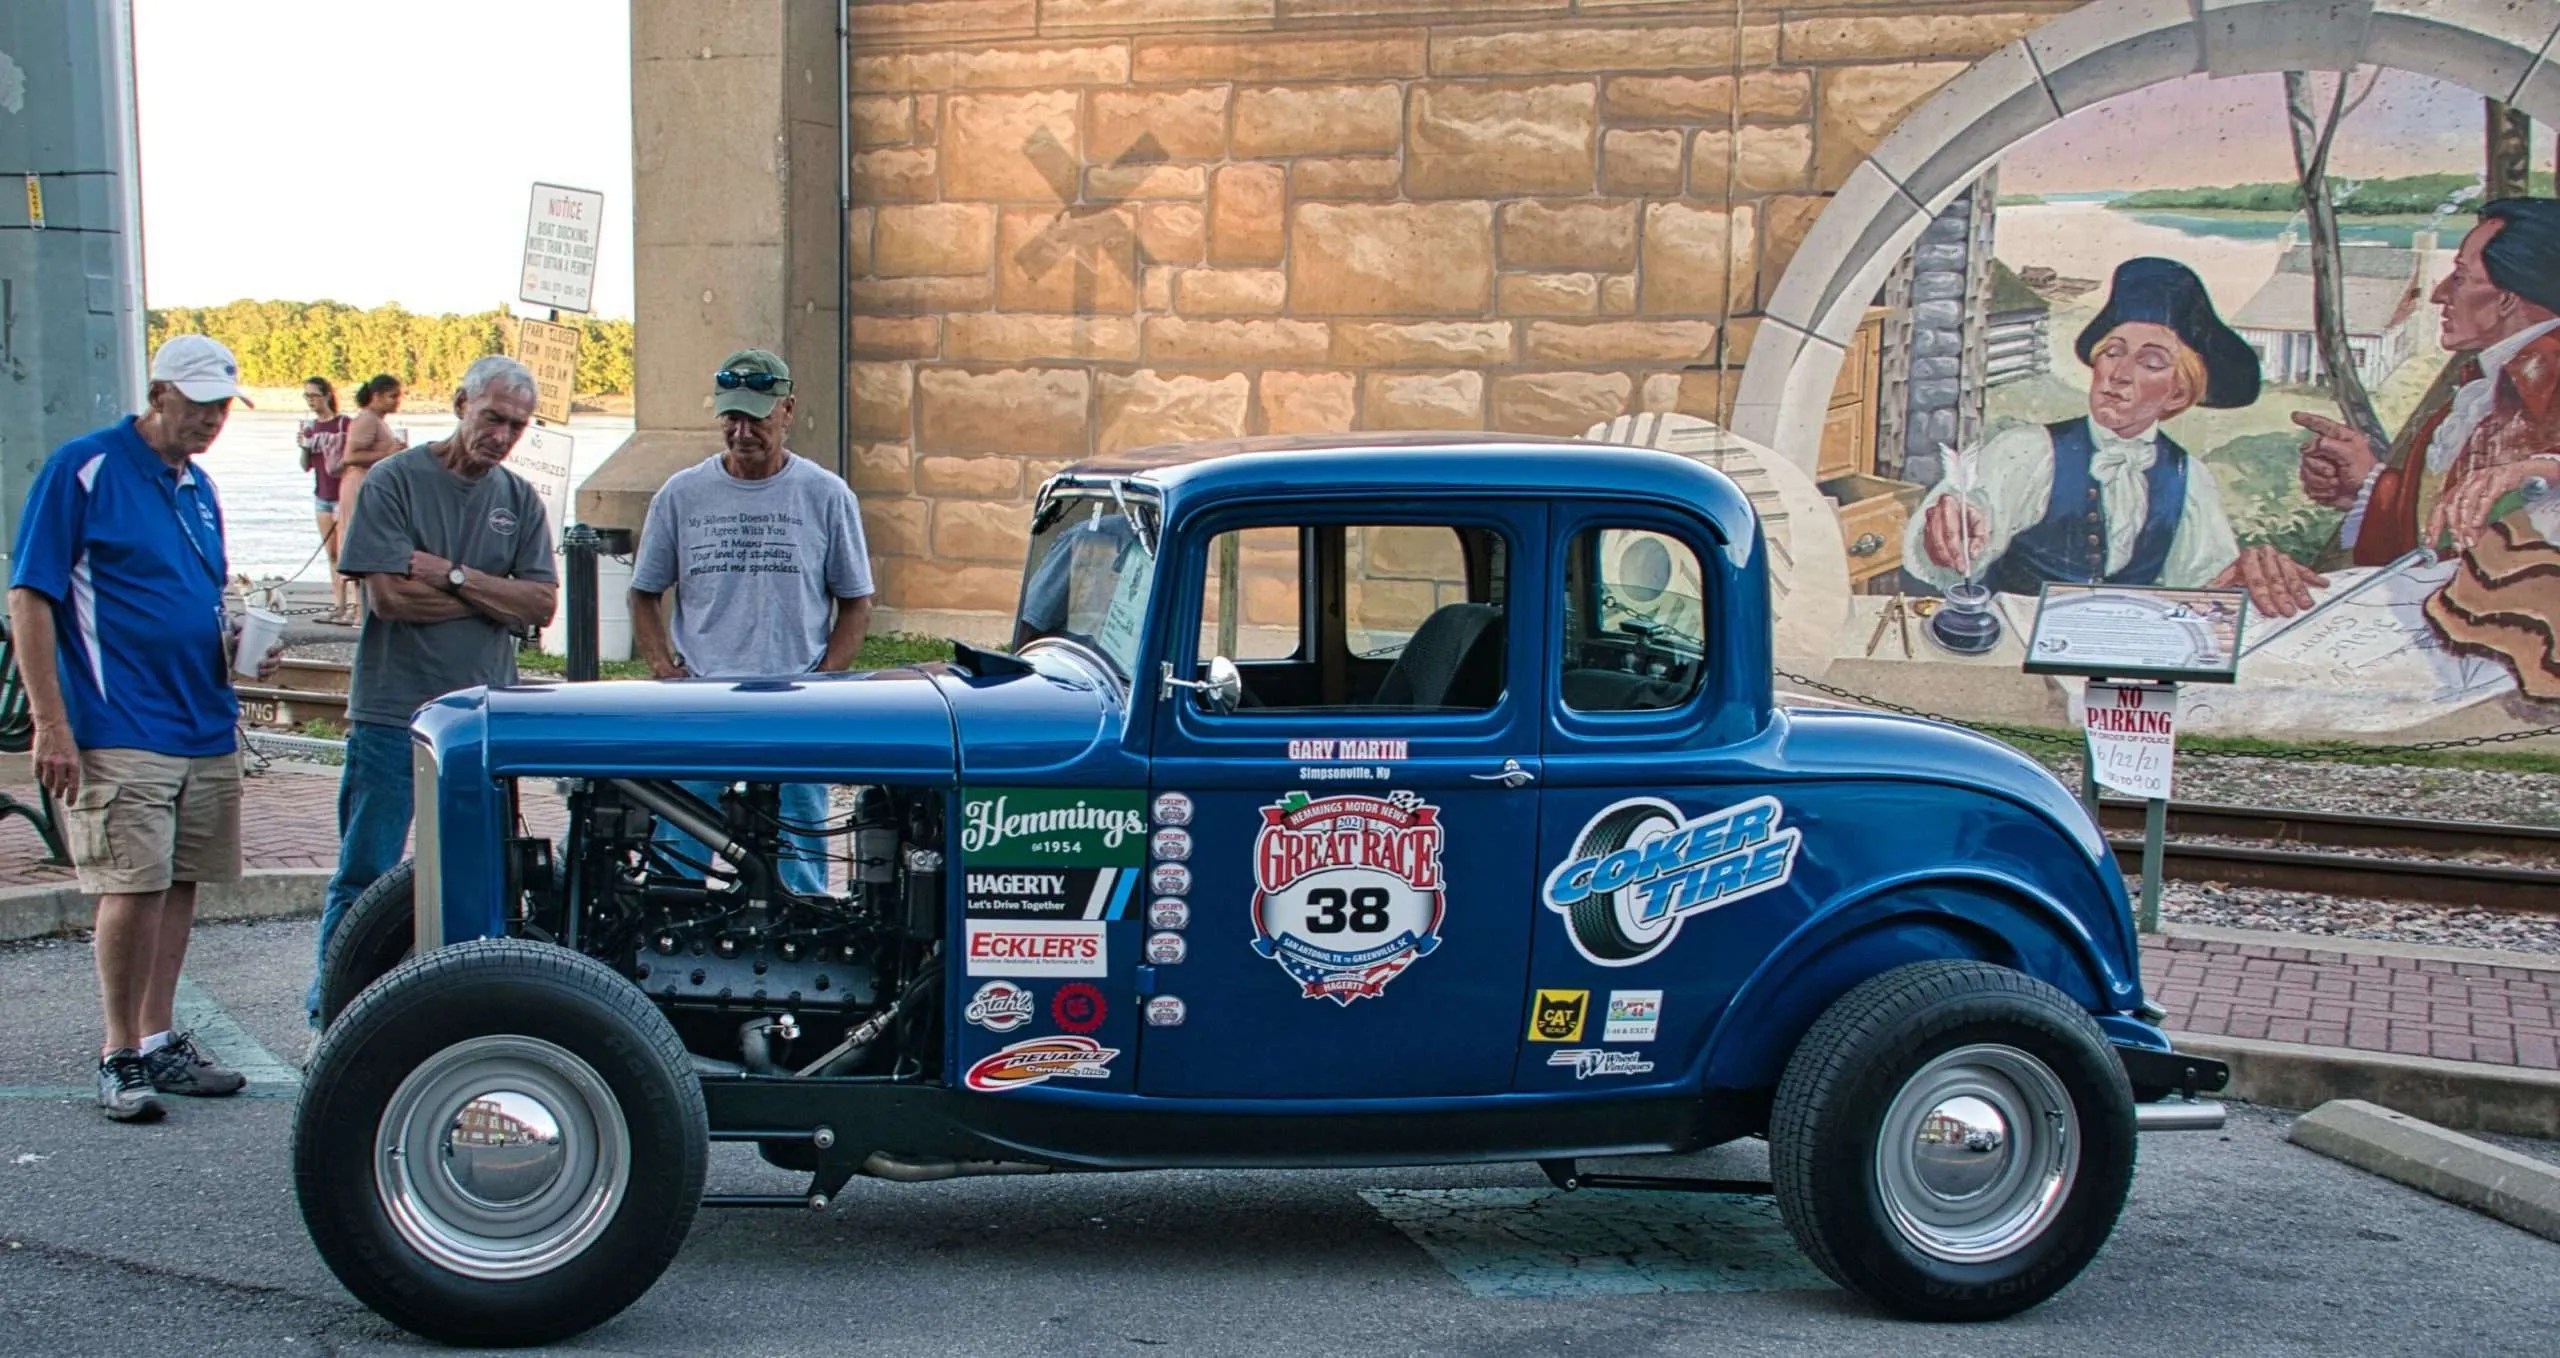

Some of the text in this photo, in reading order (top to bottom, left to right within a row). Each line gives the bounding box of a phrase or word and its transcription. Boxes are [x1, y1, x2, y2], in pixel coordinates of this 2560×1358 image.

[548, 198, 583, 220] NOTICE
[689, 517, 700, 528] My
[703, 513, 738, 525] Silence
[739, 512, 776, 523] Doesn't
[711, 527, 738, 537] Agree
[741, 525, 764, 536] With
[767, 526, 787, 536] You
[731, 539, 763, 548] Means
[714, 549, 735, 559] level
[736, 549, 747, 562] of
[750, 548, 793, 562] stupidity
[2117, 687, 2143, 709] NO
[2086, 707, 2172, 735] PARKING
[2098, 732, 2125, 742] ORDER
[2127, 735, 2139, 743] OF
[2140, 736, 2171, 745] POLICE
[1288, 740, 1409, 761] GARY MARTIN
[1299, 766, 1392, 780] Simpsonville, Ky
[1289, 801, 1409, 826] HEMMINGS MOTOR NEWS
[1338, 816, 1364, 828] 2021
[961, 795, 1149, 852] Hemmings
[1043, 840, 1083, 853] 1954
[1550, 803, 1776, 906] COKER
[1260, 829, 1436, 890] GREAT RACE
[966, 873, 1065, 895] HAGERTY
[1635, 835, 1795, 923] TIRE
[967, 899, 1065, 912] Let's Drive Together
[1306, 887, 1391, 934] 38
[970, 932, 1099, 958] ECKLER'S
[1283, 937, 1299, 951] SAN
[1332, 954, 1342, 963] TX
[1397, 937, 1409, 948] SC
[1323, 981, 1364, 992] HAGERTY
[1544, 1009, 1575, 1026] CAT
[1545, 1026, 1568, 1034] SCALE
[1009, 1051, 1105, 1065] RELIABLE
[1604, 1053, 1638, 1064] Wheel
